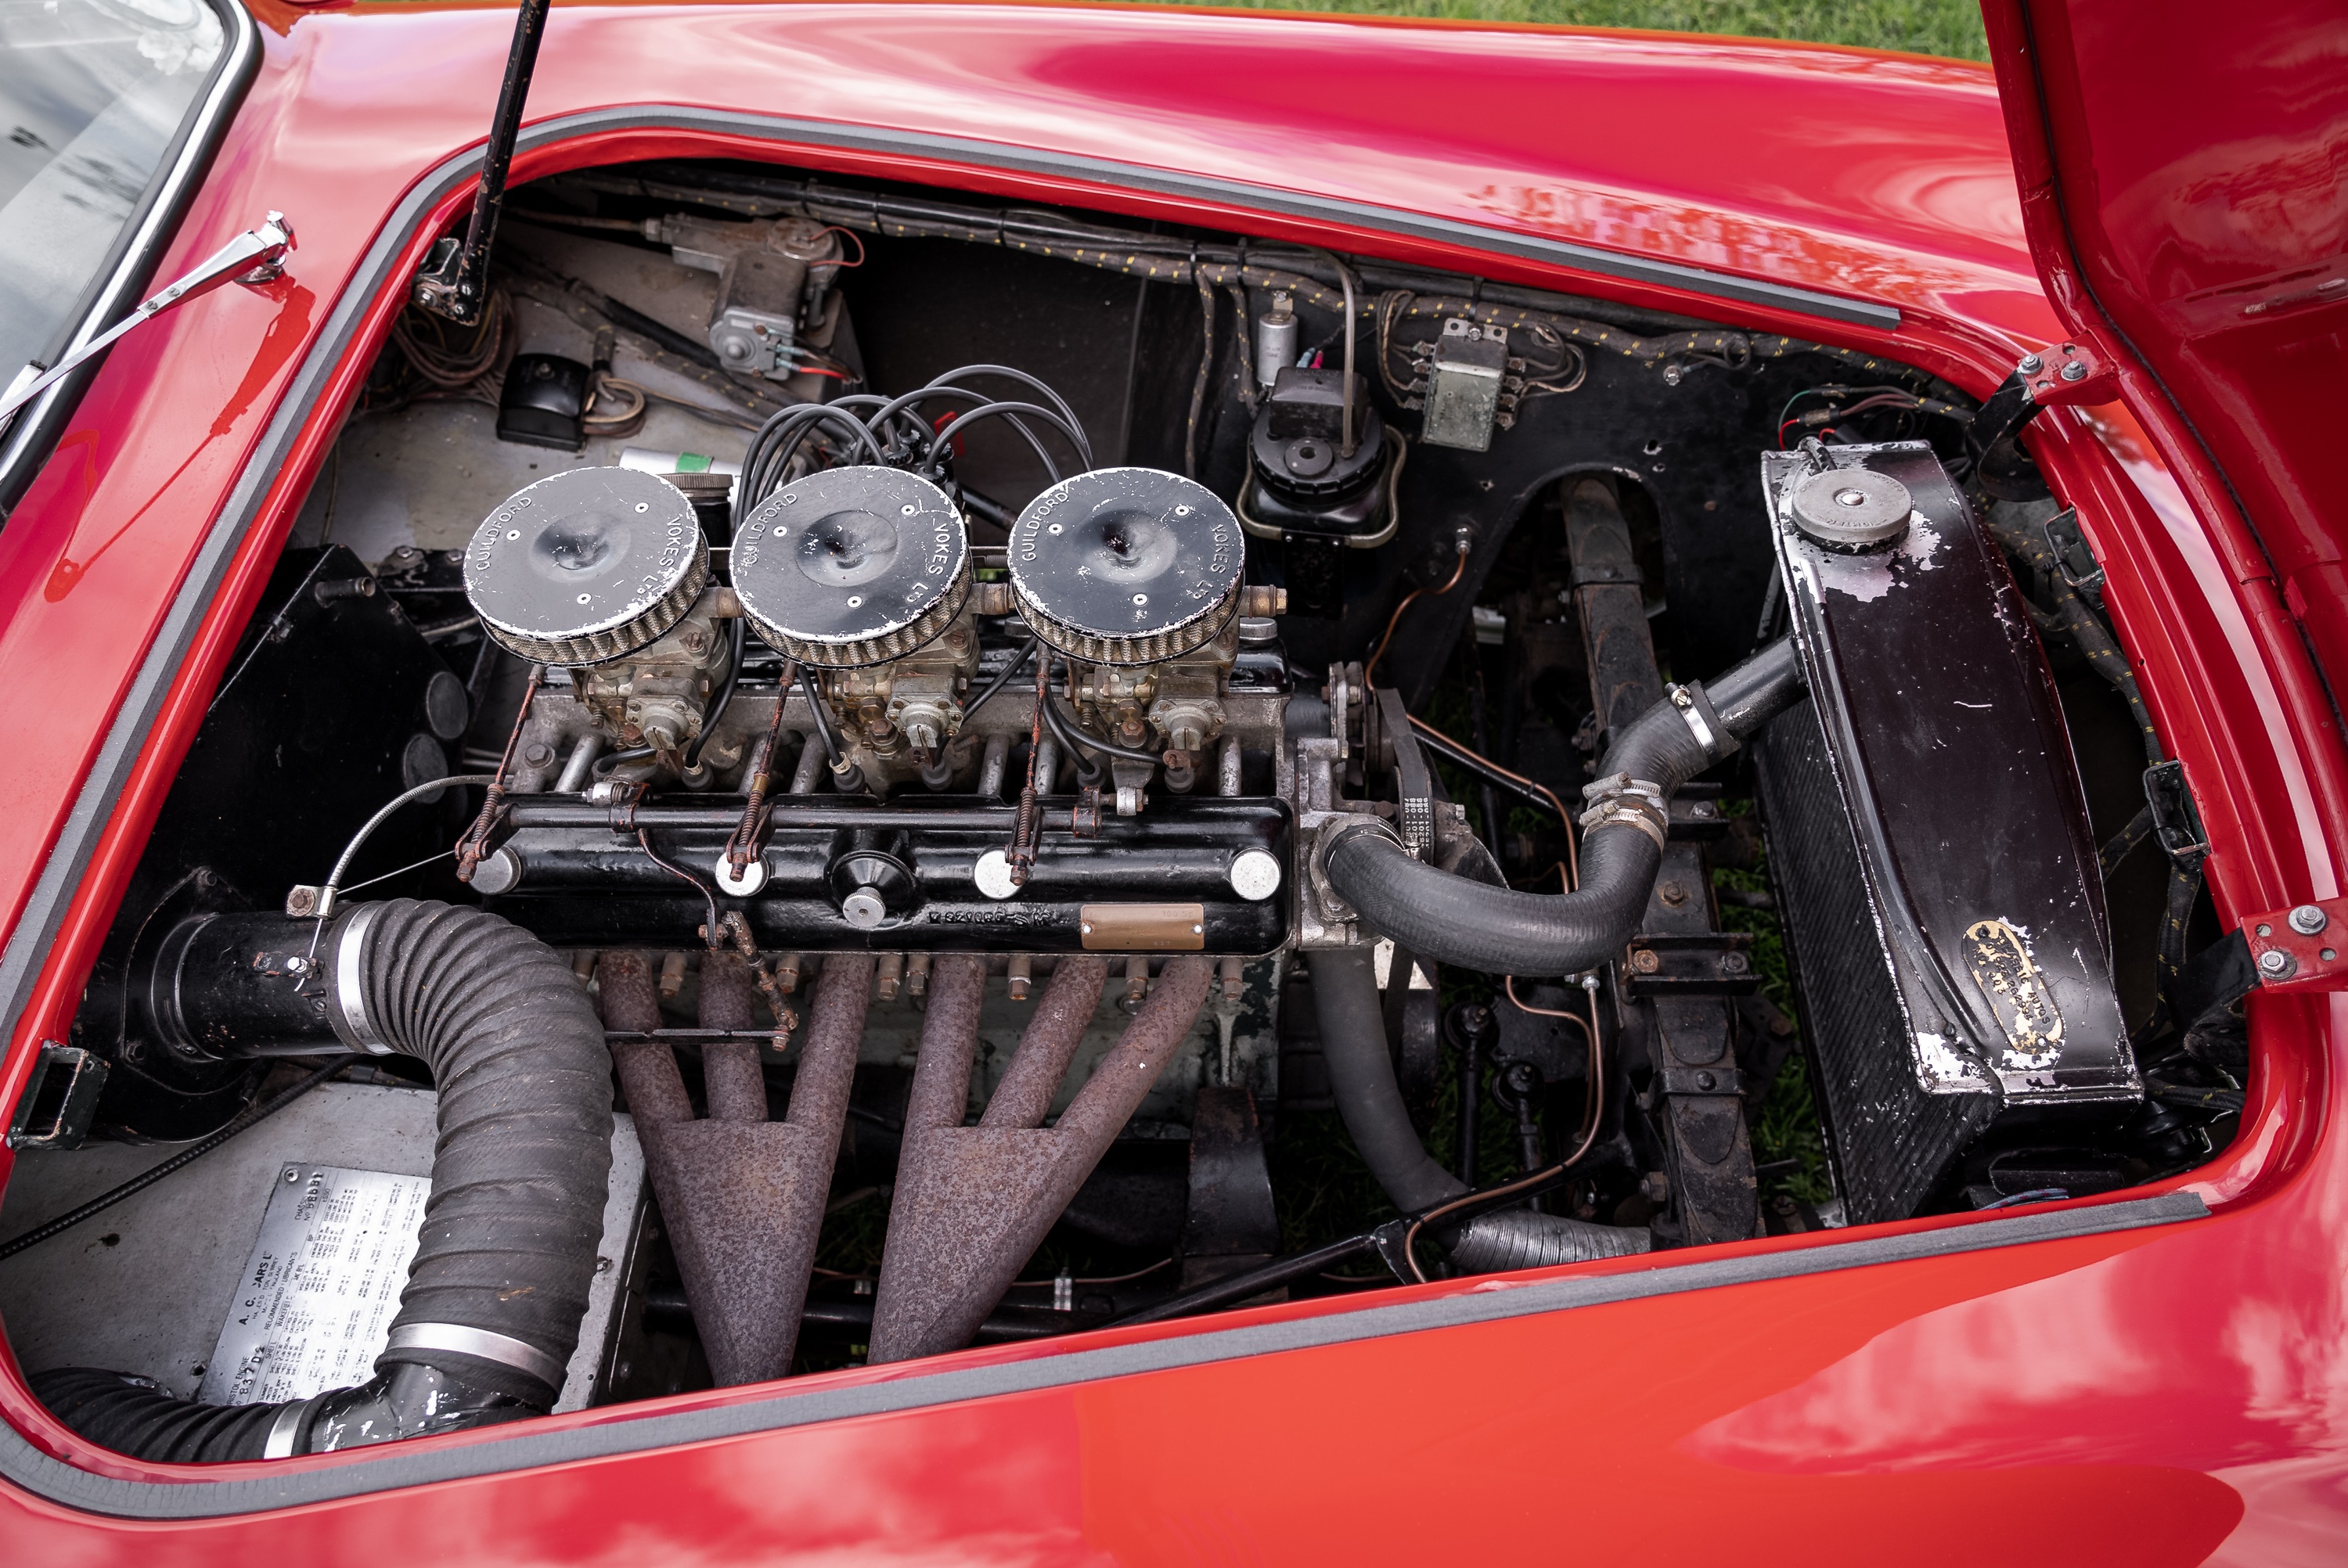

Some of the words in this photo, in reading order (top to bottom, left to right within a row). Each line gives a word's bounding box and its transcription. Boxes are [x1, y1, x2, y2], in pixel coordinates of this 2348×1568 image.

[476, 497, 533, 570] GUILDFORD
[659, 516, 684, 567] VOKES
[745, 493, 798, 565] GUILDFORD
[928, 523, 949, 576] VOKES
[1021, 491, 1069, 561] GUILDFORD
[1211, 523, 1231, 574] VOKES
[1997, 935, 2029, 984] CLASSIC
[2029, 990, 2051, 1023] AUTOS
[2006, 979, 2031, 1020] 262994
[295, 1195, 308, 1220] CHASSIS
[239, 1314, 250, 1325] A.
[244, 1296, 256, 1307] C.
[264, 1286, 284, 1329] RECOMMENDED
[226, 1382, 240, 1404] RISTOL
[235, 1356, 249, 1379] ENGINE
